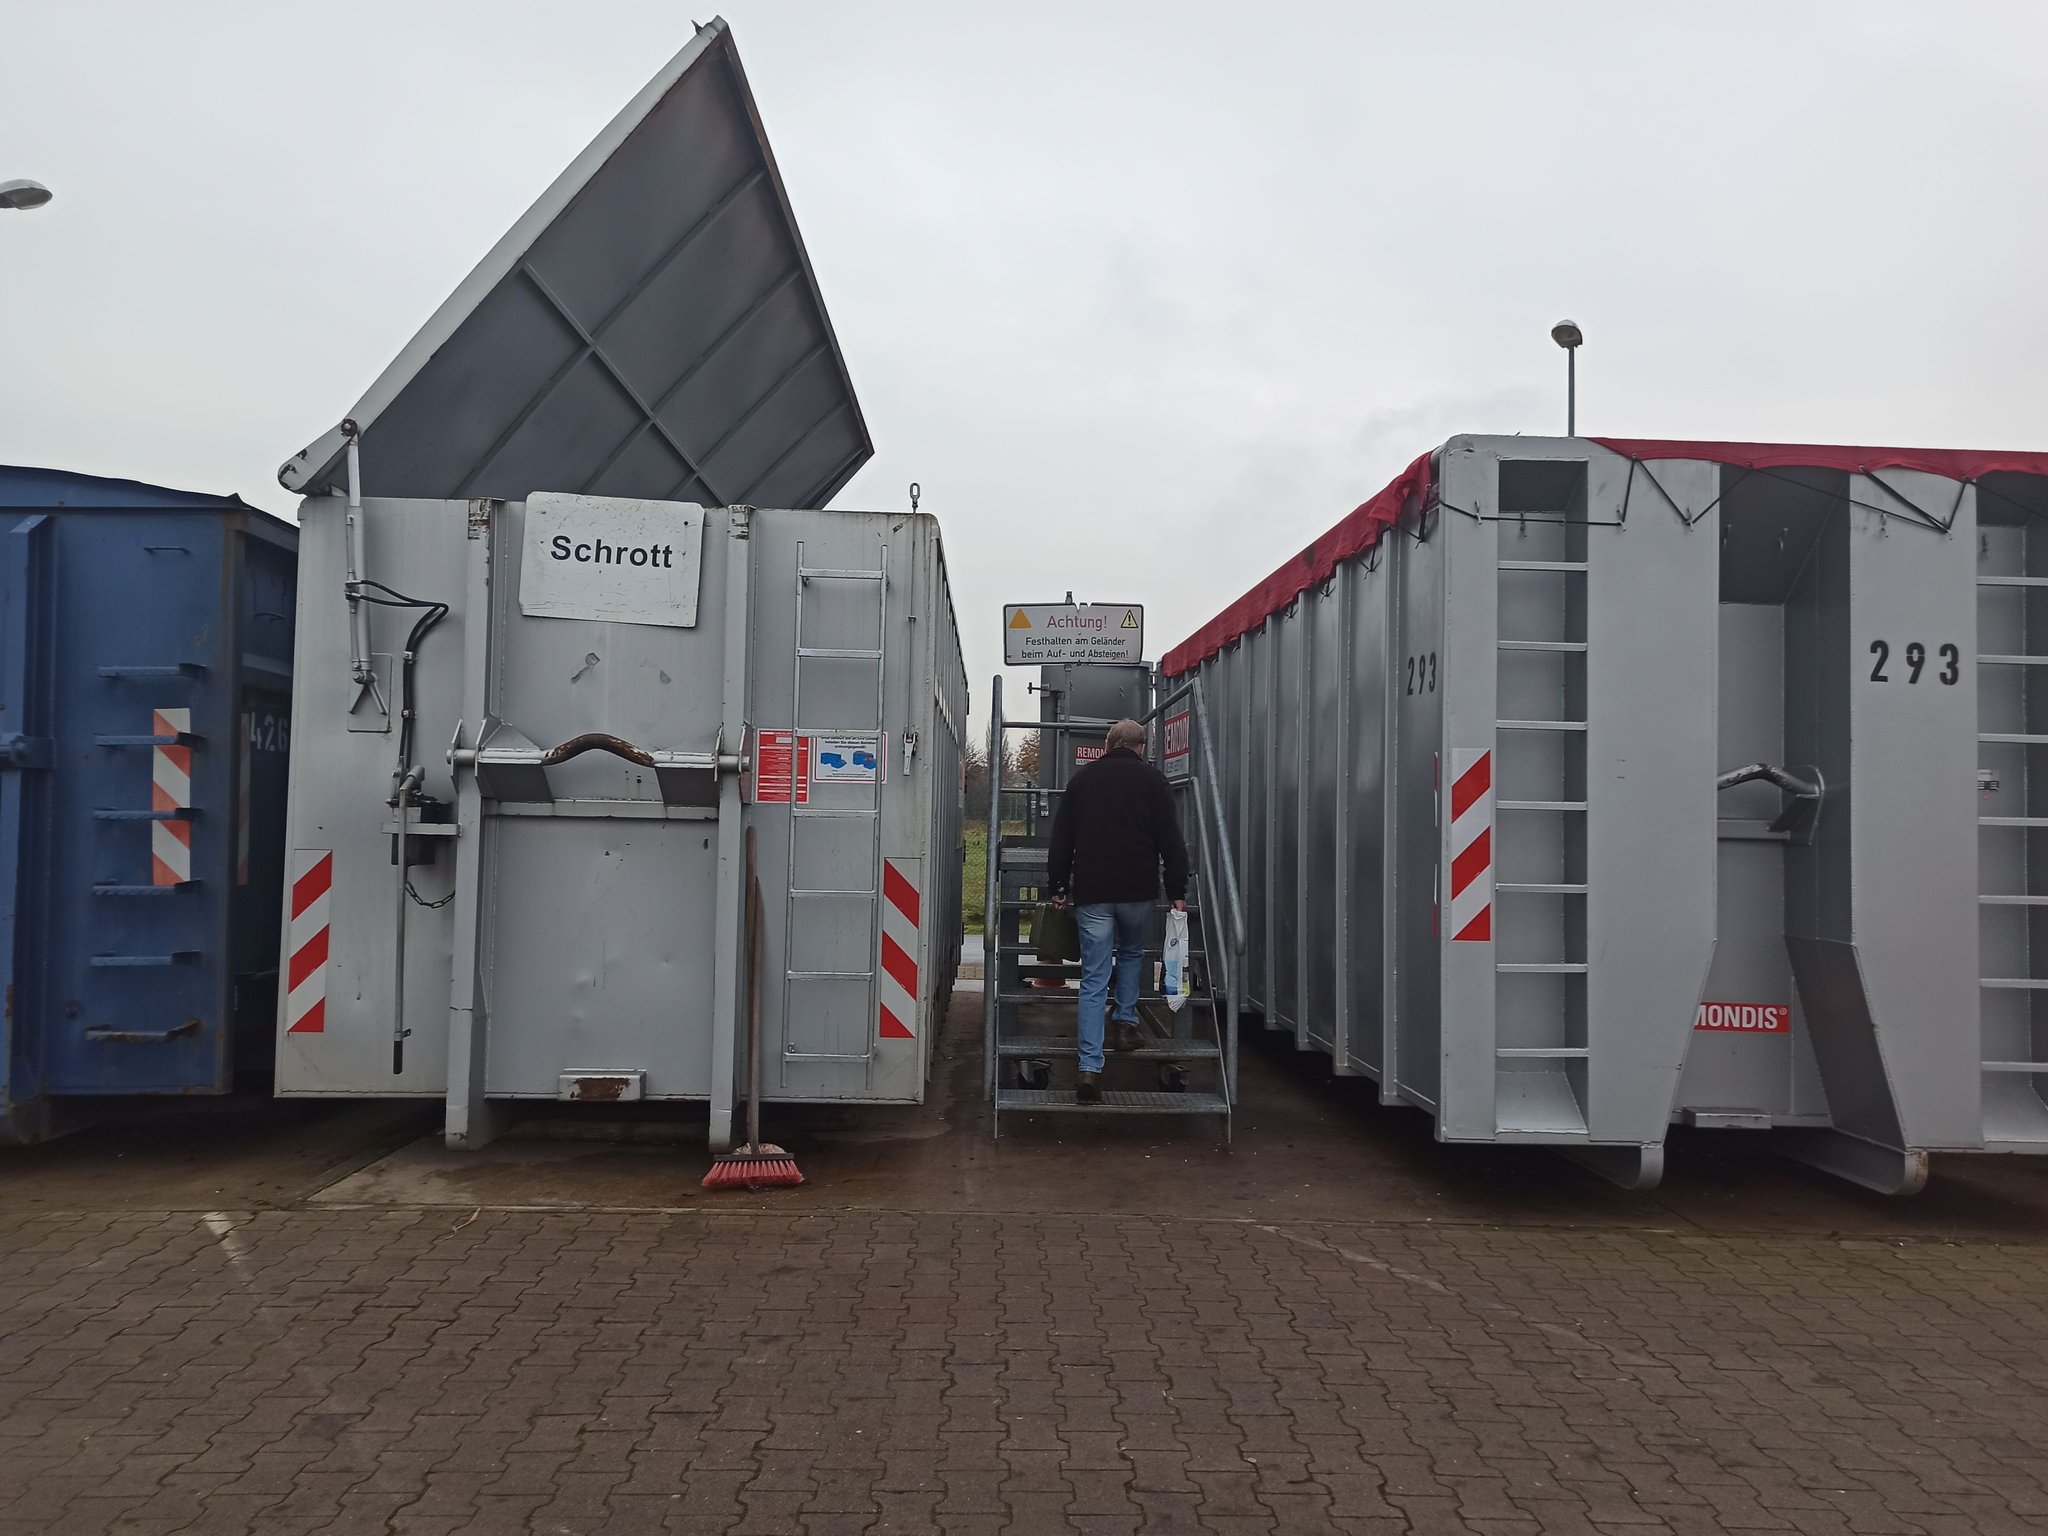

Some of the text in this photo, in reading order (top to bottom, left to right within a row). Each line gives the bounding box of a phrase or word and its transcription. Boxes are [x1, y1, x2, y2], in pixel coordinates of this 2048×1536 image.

[550, 535, 673, 568] Schrott
[1047, 615, 1107, 631] Achtung!
[1021, 649, 1129, 660] beim Auf- und Absteigen!
[1025, 637, 1072, 646] Festhalten
[1091, 636, 1126, 646] Geländer
[1407, 652, 1437, 696] 293
[1870, 640, 1959, 686] 293
[250, 711, 289, 753] 426
